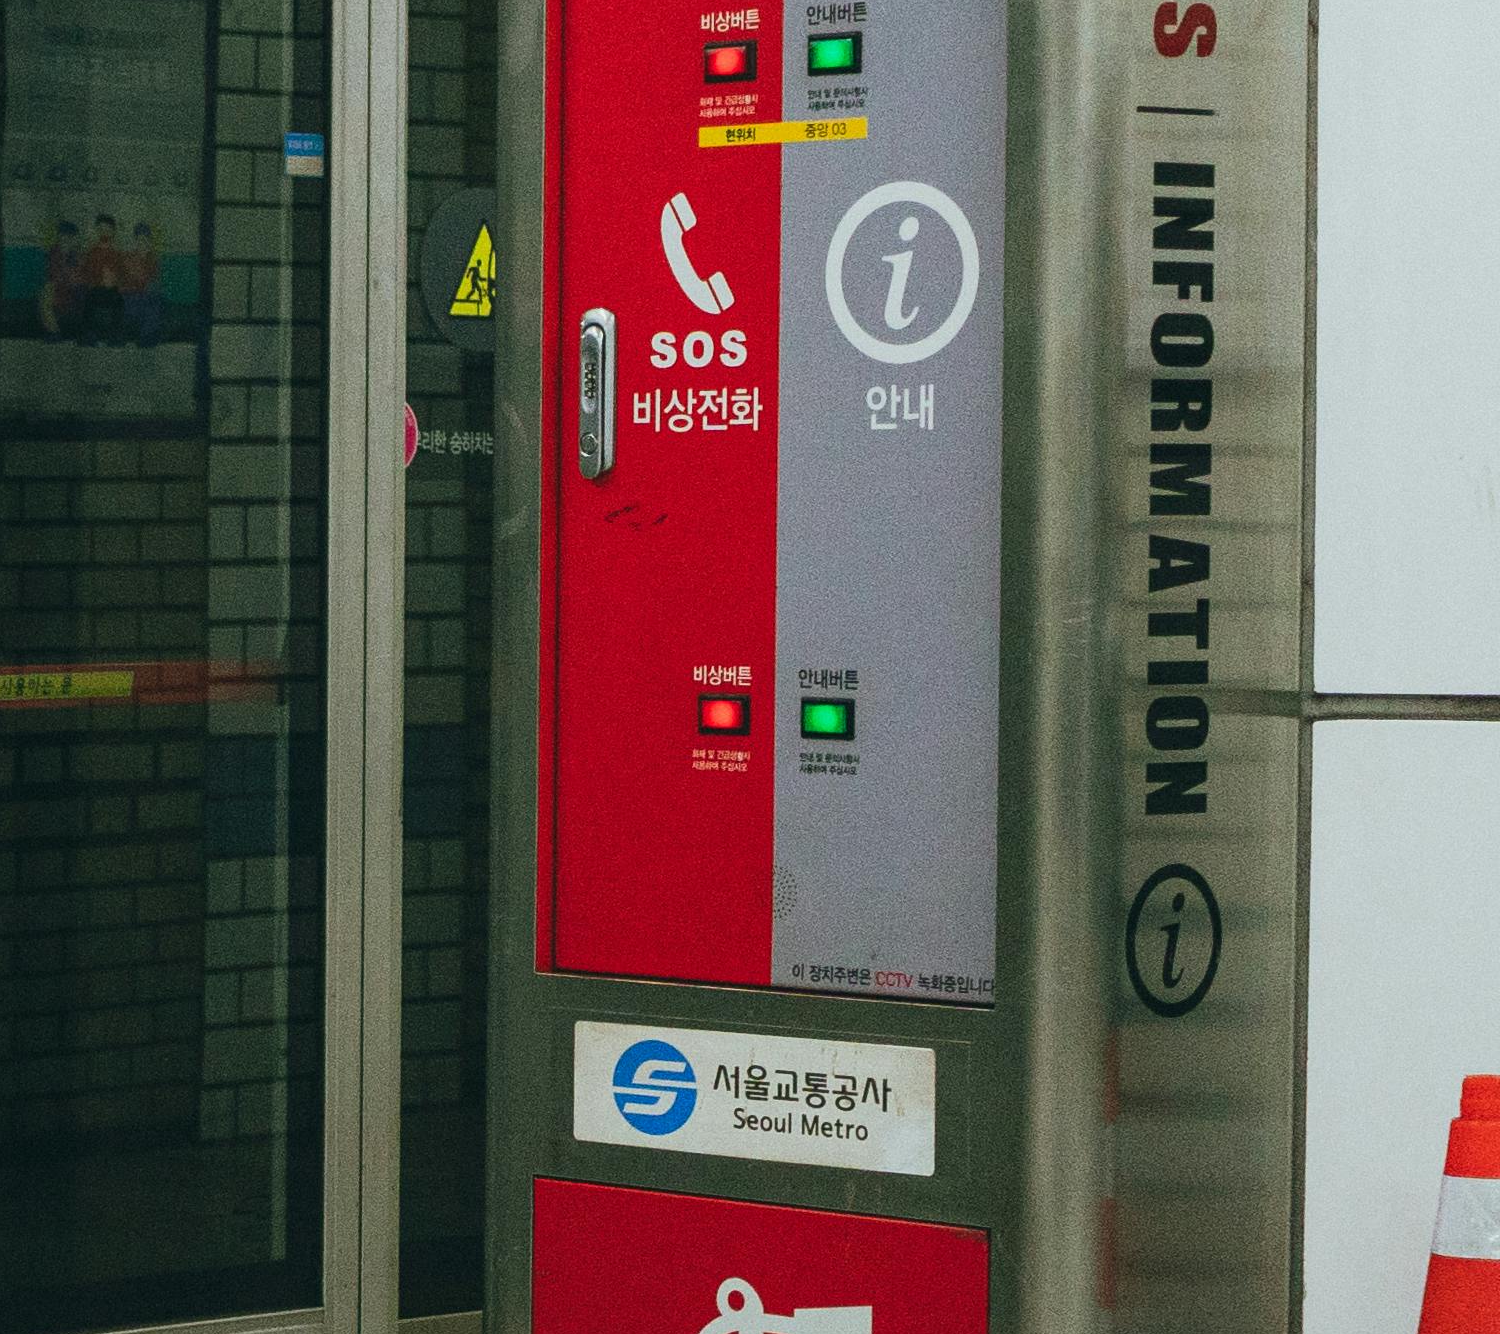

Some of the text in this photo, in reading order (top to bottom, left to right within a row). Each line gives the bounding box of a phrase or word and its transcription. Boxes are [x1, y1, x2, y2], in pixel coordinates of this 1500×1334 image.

[700, 8, 760, 33] 비상버튼
[806, 1, 868, 26] 안내버튼
[726, 123, 847, 142] 현위치 중앙 03
[650, 329, 748, 369] SOS
[632, 384, 763, 434] 비상전화
[865, 384, 936, 431] 안내
[419, 430, 446, 454] 리한
[1148, 161, 1216, 816] INFORMATION
[693, 665, 753, 686] 비상버튼
[799, 669, 859, 690] 안내버튼
[792, 964, 805, 980] 이
[809, 965, 871, 986] 장치주변은
[875, 971, 914, 988] CCTV
[712, 1062, 892, 1113] 서울교통공사
[733, 1107, 869, 1142] Seoul Metro
